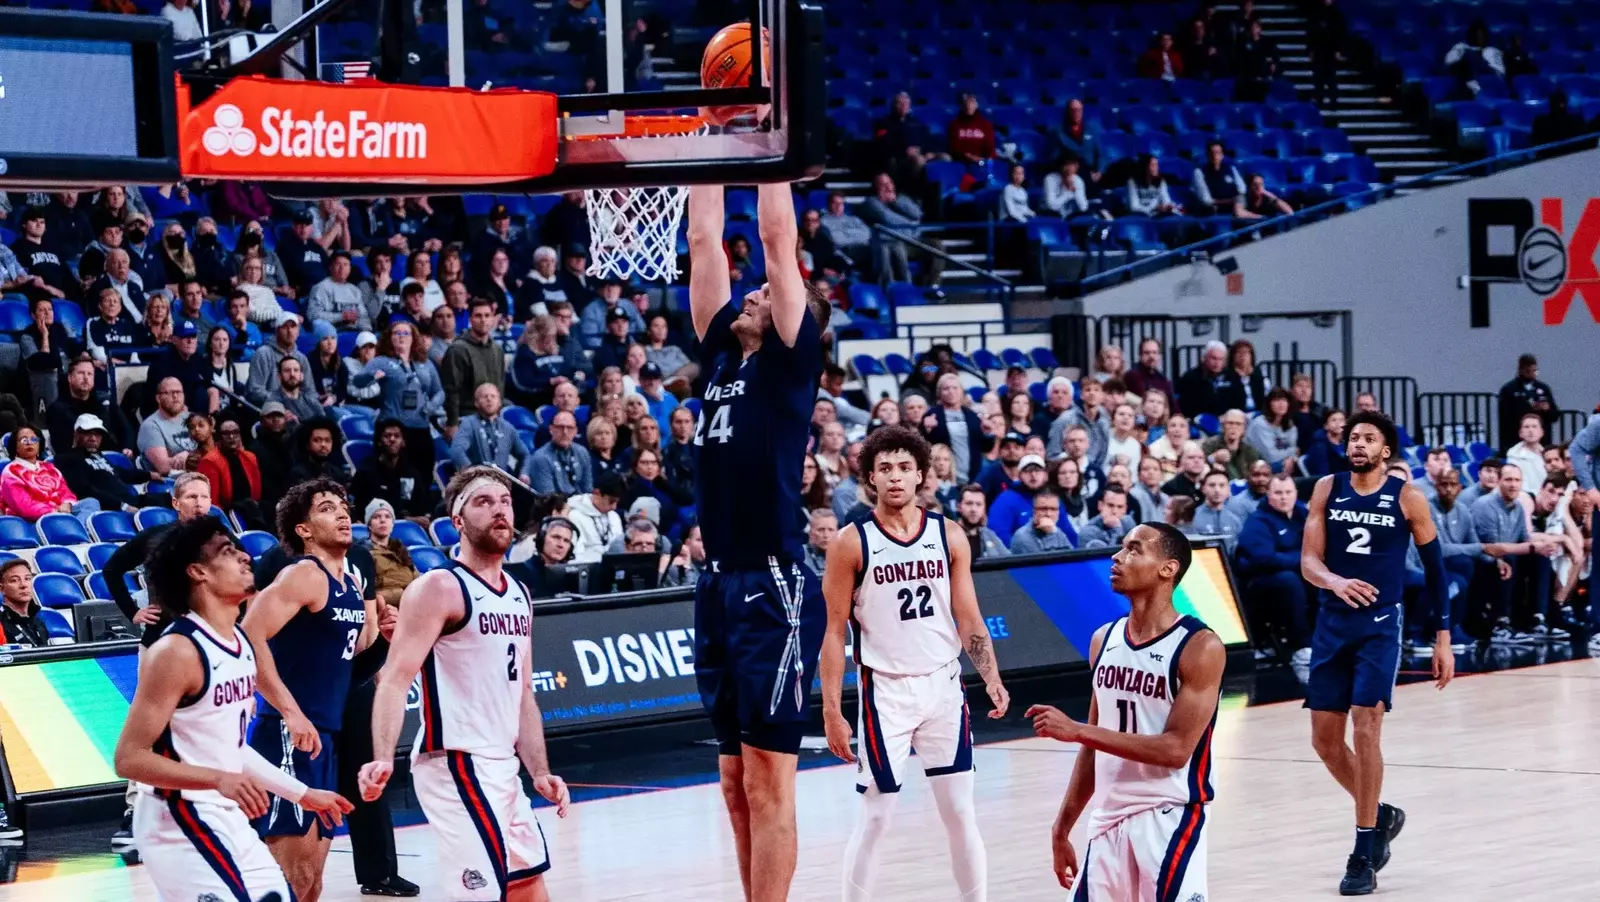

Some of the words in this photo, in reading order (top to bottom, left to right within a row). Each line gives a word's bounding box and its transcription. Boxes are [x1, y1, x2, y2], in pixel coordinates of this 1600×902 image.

[704, 380, 746, 401] VIER
[1328, 508, 1396, 527] XAVIER
[1345, 526, 1372, 555] 2
[872, 559, 944, 585] GONZAGA
[331, 607, 366, 624] XAVIE
[897, 585, 934, 621] 22
[987, 616, 1009, 638] EE
[341, 628, 359, 660] 3
[572, 628, 696, 688] DISNE
[507, 643, 518, 681] 2
[1097, 665, 1167, 700] GONZAGA
[1116, 699, 1138, 734] 11
